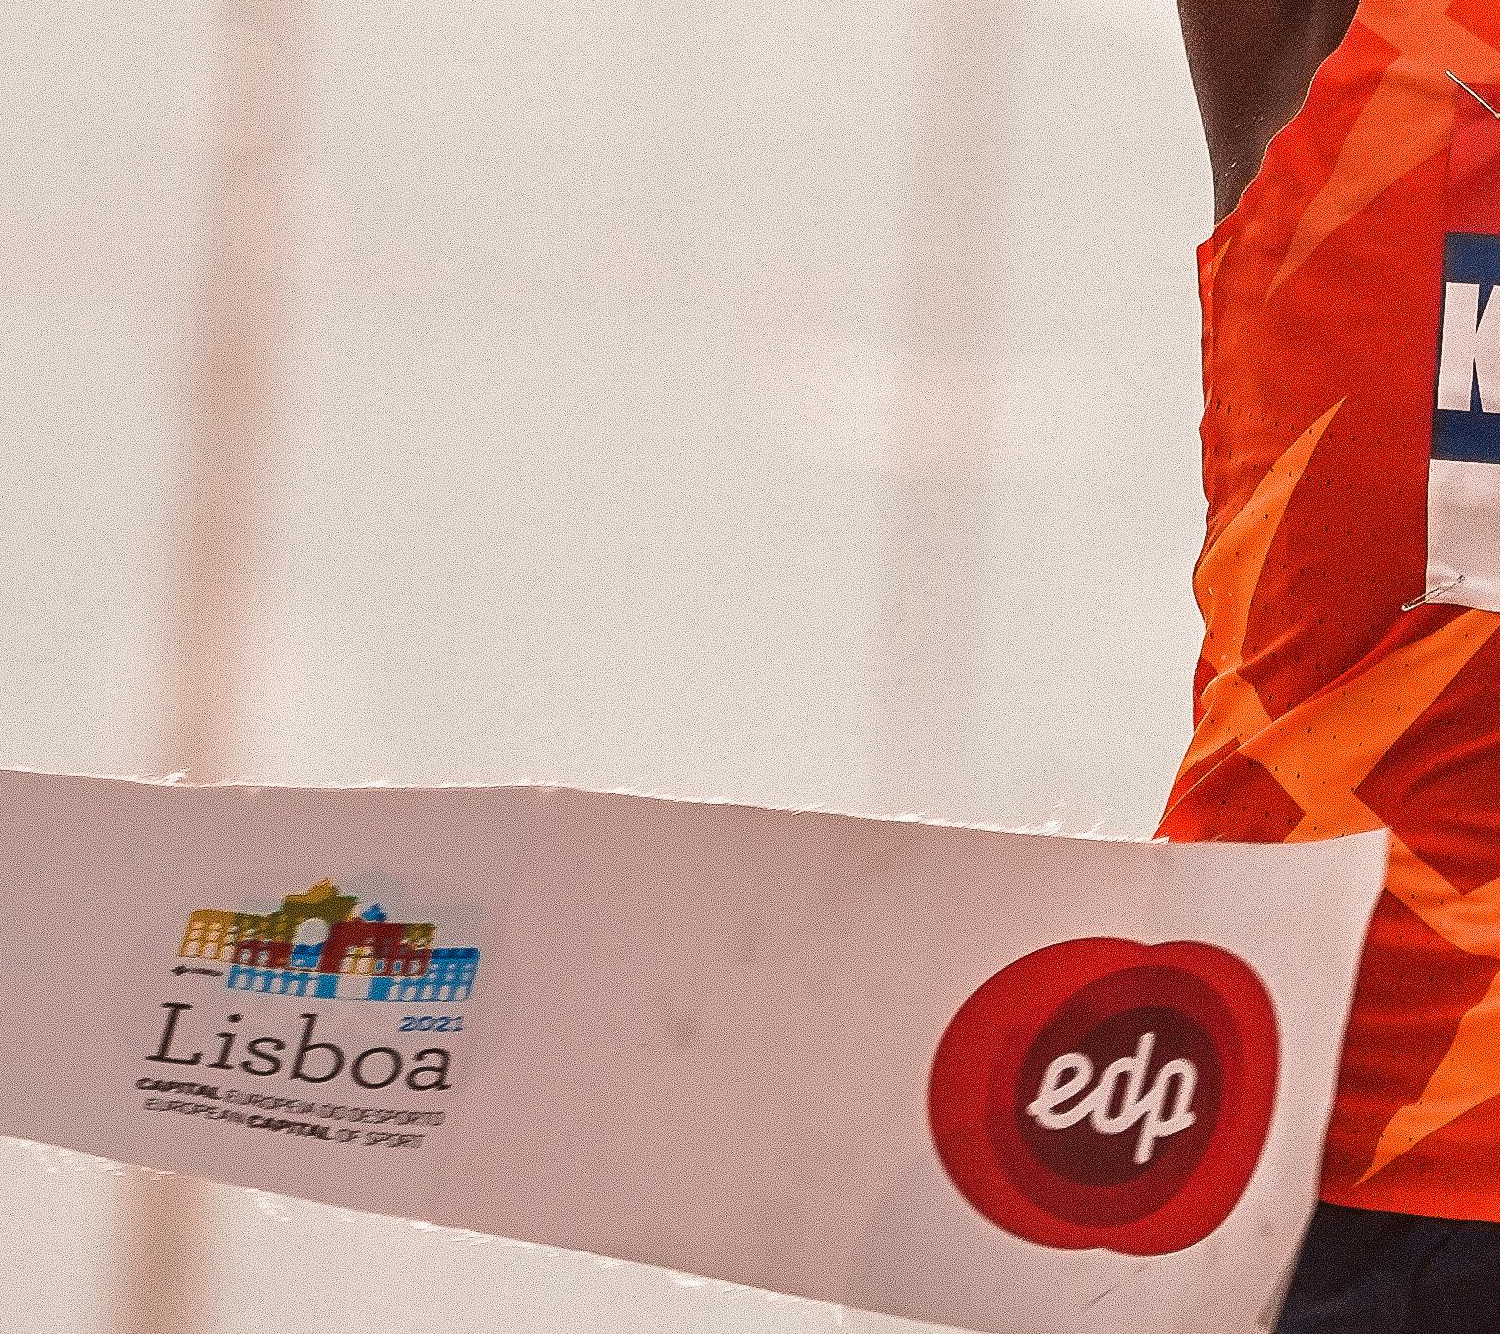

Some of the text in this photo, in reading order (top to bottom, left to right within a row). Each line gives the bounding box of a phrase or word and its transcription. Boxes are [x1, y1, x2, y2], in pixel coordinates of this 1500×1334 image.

[398, 1015, 464, 1032] 2021
[145, 1002, 452, 1091] Lisboa
[135, 1077, 222, 1100] CAPITAL
[1025, 1031, 1198, 1163] edp
[247, 1113, 332, 1140] CAPITAL
